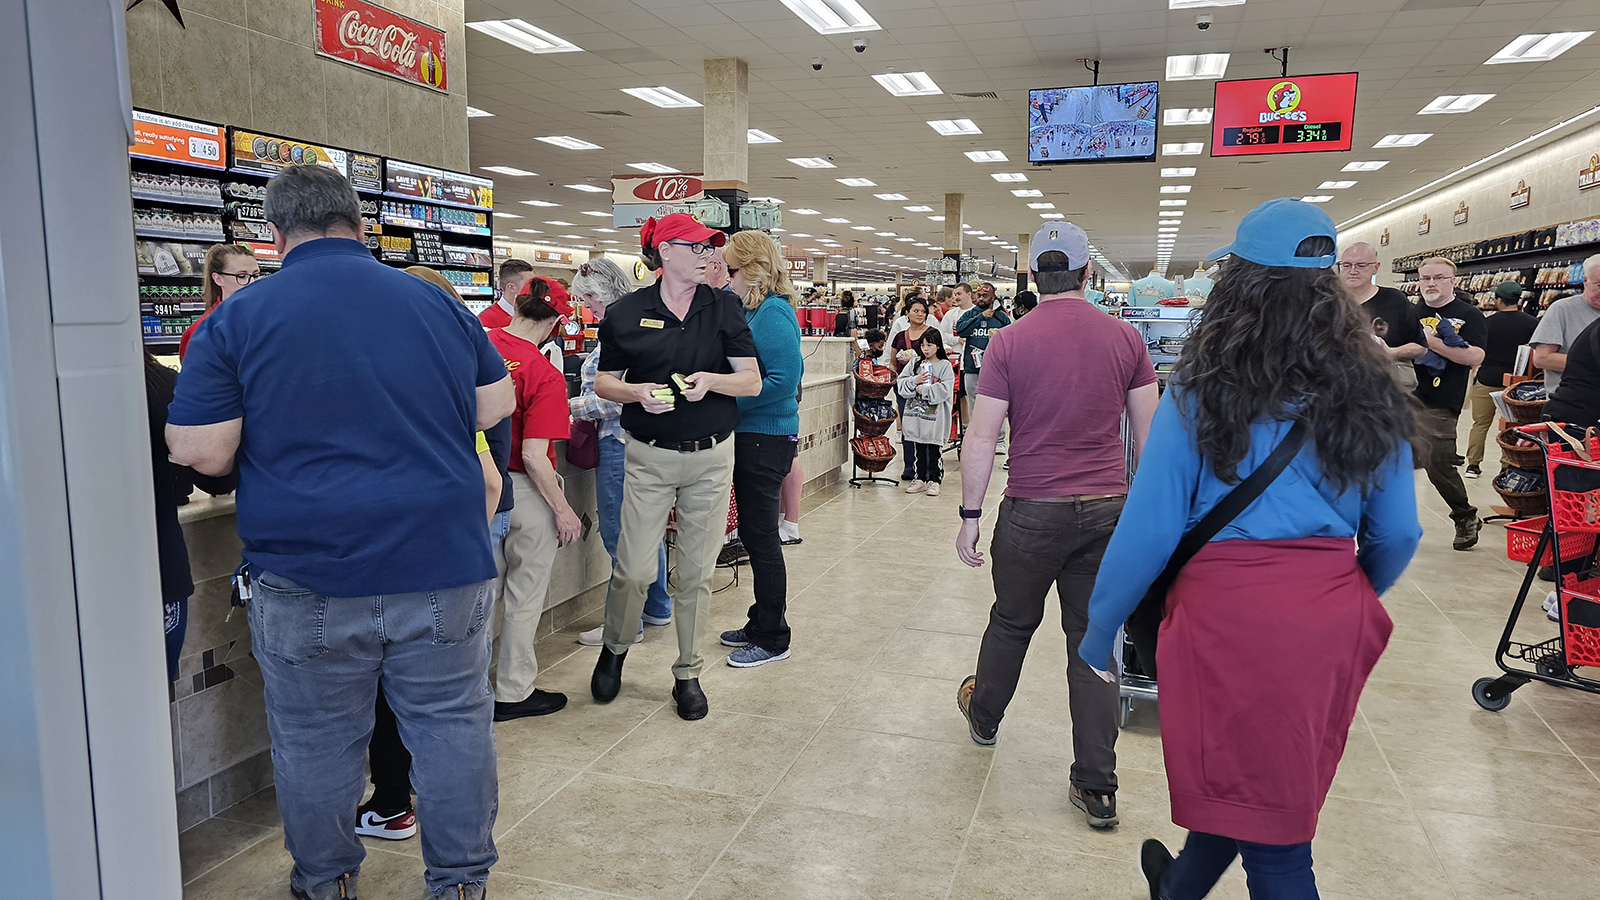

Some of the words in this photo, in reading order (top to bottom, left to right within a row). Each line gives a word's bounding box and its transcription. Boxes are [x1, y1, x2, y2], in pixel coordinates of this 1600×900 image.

[339, 10, 418, 69] Coca-Cola
[136, 113, 158, 122] Nicotine
[172, 120, 194, 130] addictive
[142, 131, 159, 140] really
[159, 133, 185, 145] satisfying
[191, 143, 197, 153] 3
[395, 175, 410, 183] SAVE
[654, 178, 688, 200] 10%
[675, 190, 687, 199] off
[794, 260, 806, 270] UP
